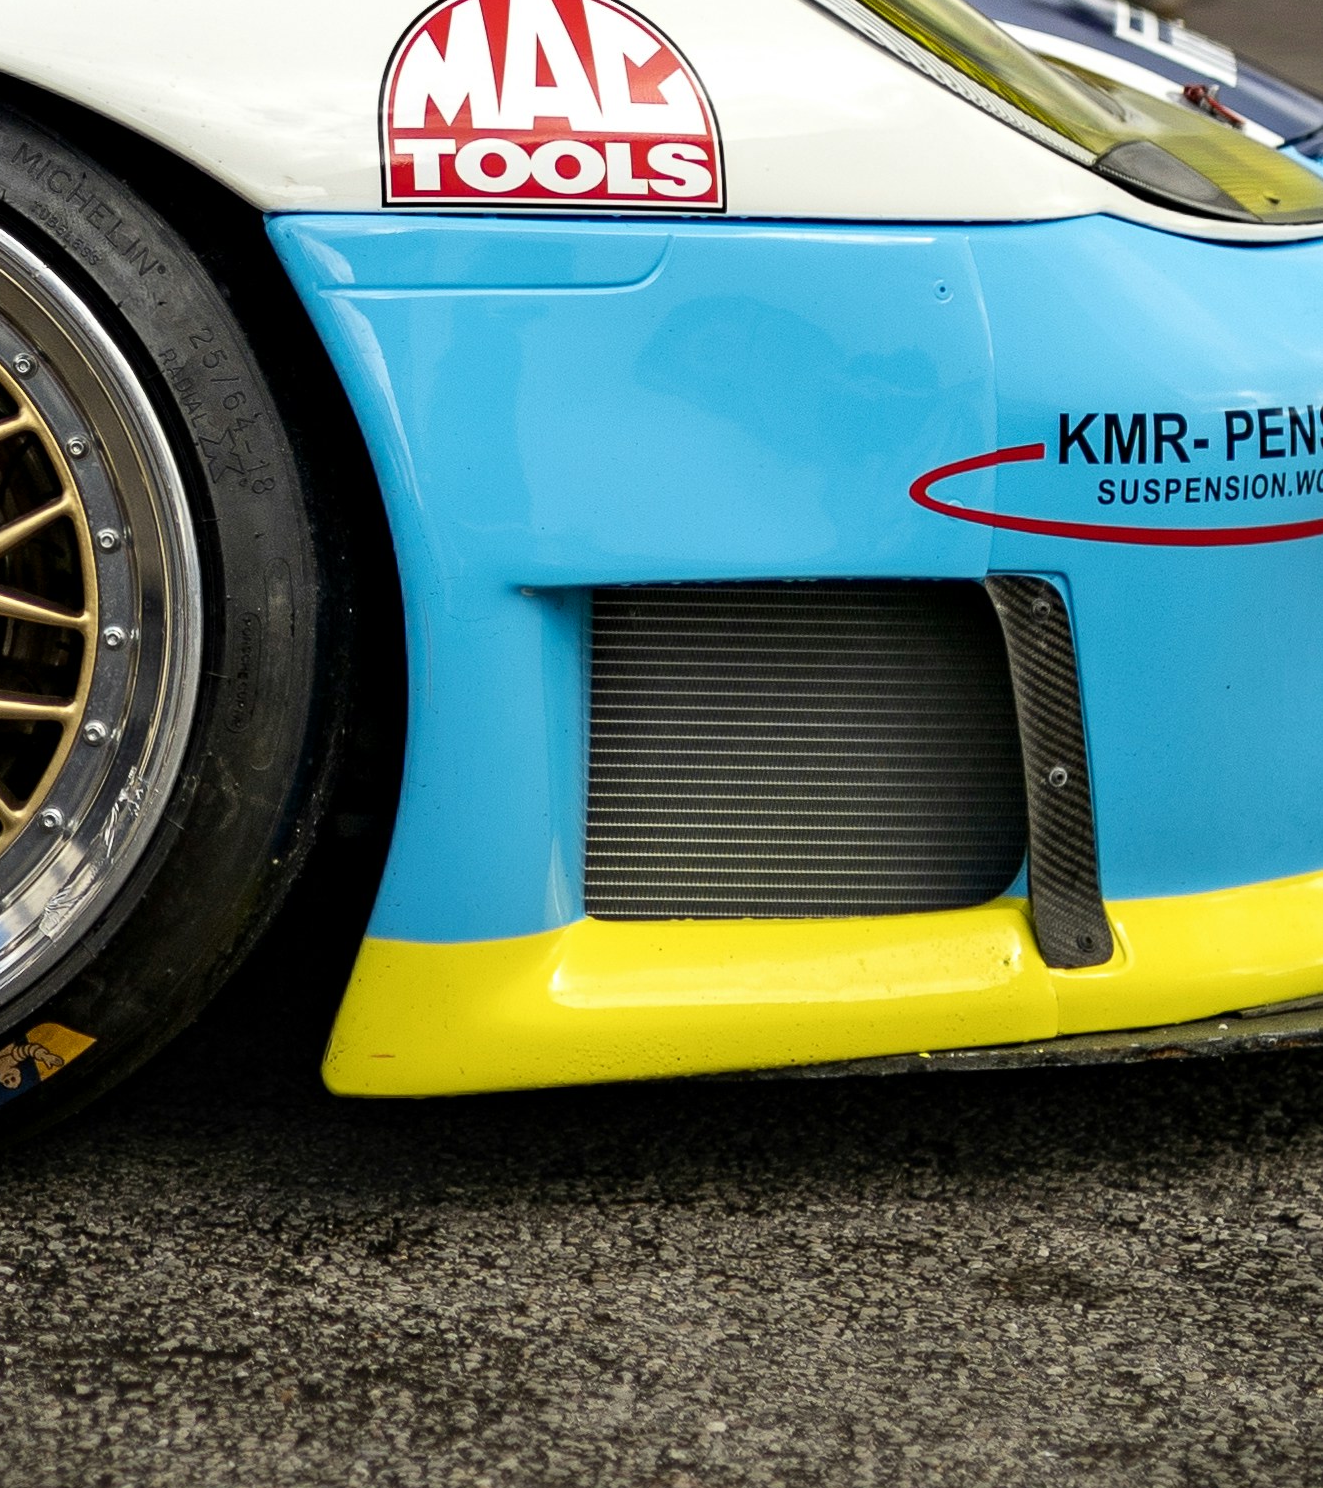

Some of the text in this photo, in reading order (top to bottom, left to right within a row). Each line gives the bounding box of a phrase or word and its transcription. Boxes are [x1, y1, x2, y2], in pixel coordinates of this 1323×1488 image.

[393, 138, 714, 199] TOOLS
[158, 348, 207, 429] RADIAL
[1058, 405, 1323, 465] KMR- PEN
